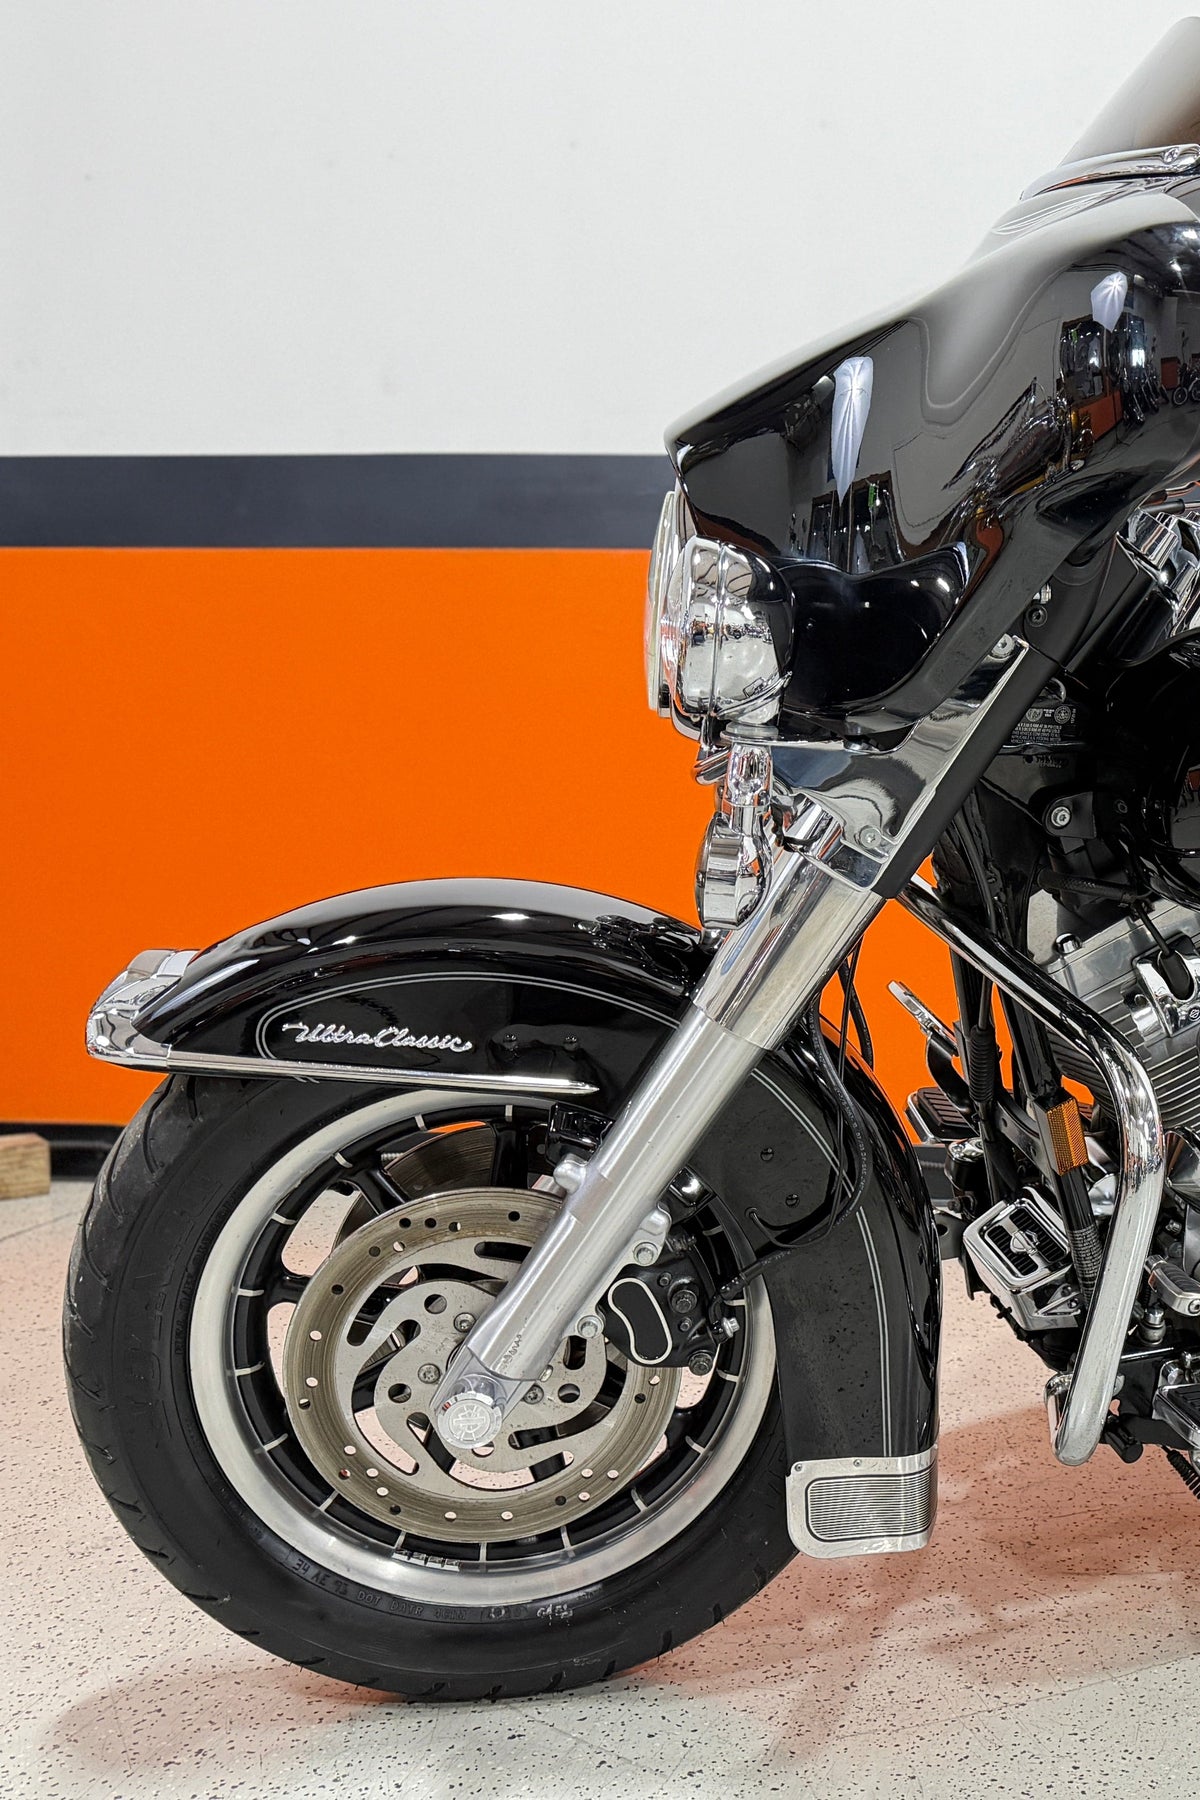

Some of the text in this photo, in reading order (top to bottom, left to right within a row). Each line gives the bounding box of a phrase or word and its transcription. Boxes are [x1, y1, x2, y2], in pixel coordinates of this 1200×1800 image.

[282, 1021, 473, 1053] Ultra Classic
[356, 1590, 381, 1605] DOT
